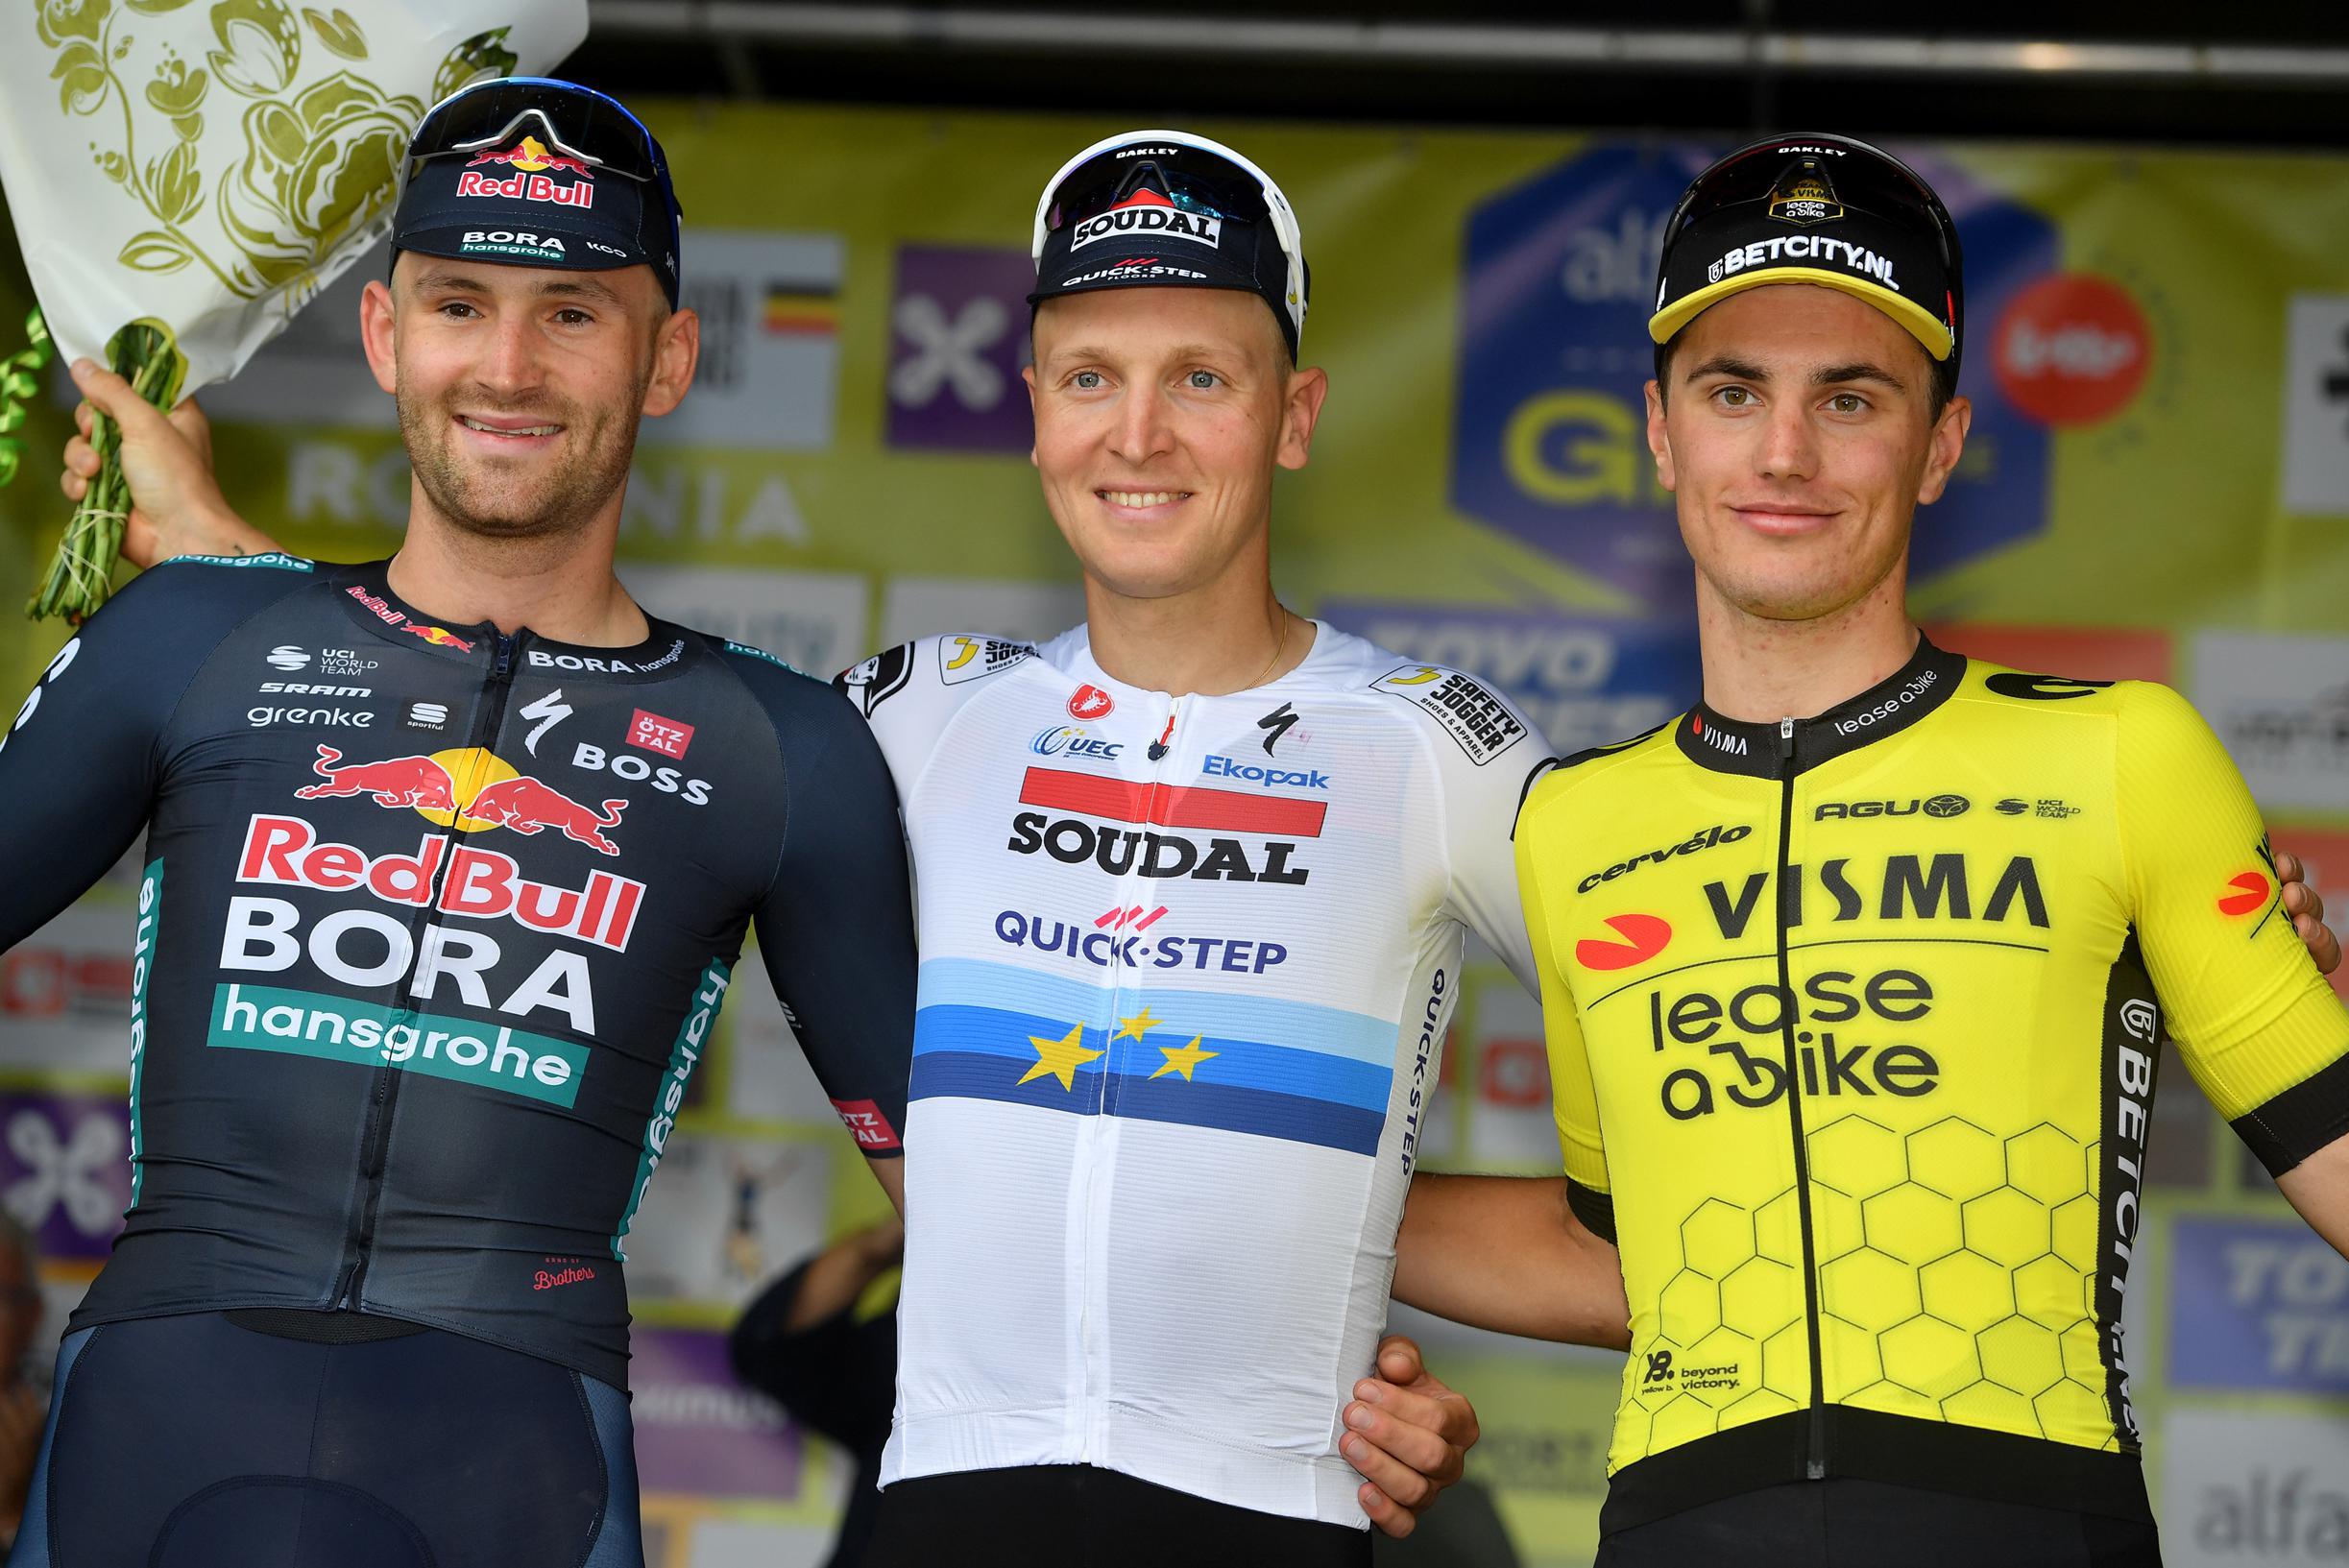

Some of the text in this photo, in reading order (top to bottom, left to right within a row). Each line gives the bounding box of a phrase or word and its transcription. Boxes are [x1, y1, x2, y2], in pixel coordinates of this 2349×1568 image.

[1115, 148, 1179, 159] OAKLEY
[1779, 147, 1847, 157] OAKLEY
[456, 171, 594, 208] Red Bull
[1074, 208, 1217, 246] SOUDAL
[462, 230, 566, 253] BORA
[463, 243, 562, 259] hansgrohe
[1724, 234, 1901, 291] BETCITY.NL
[345, 586, 406, 625] Red Bull
[321, 657, 378, 669] WORLD
[322, 648, 355, 659] UCI
[528, 639, 686, 673] BORA hansgrohe
[320, 665, 362, 676] TEAM
[258, 682, 373, 698] SRAM
[1834, 669, 1938, 737] lease a bike
[247, 707, 375, 728] grenke
[1430, 684, 1506, 752] JOGGER
[1445, 674, 1521, 736] SAFETY
[407, 720, 444, 731] sportful
[639, 716, 685, 742] ÖTZ
[1419, 698, 1486, 760] SHOES & APPAREL
[636, 731, 678, 754] TAL
[1068, 738, 1125, 757] UEC
[1703, 725, 1748, 756] VISMA
[571, 742, 714, 807] BOSS
[1202, 755, 1330, 789] Ekopak
[1814, 799, 1920, 821] AGU
[2035, 806, 2081, 814] WORLD
[2035, 810, 2068, 819] TEAM
[1007, 812, 1310, 885] SOUDAL
[1577, 825, 1753, 894] cervélo
[234, 812, 647, 954] Red Bull
[1703, 854, 2051, 941] VISMA
[218, 895, 595, 1037] BORA
[1651, 969, 1933, 1052] lease
[222, 982, 572, 1086] hansgrohe
[1661, 1031, 1940, 1122] a bike
[533, 1266, 595, 1291] Brothers
[1681, 1363, 1738, 1379] beyond
[1681, 1379, 1740, 1390] victory.
[1641, 1386, 1664, 1395] yellow
